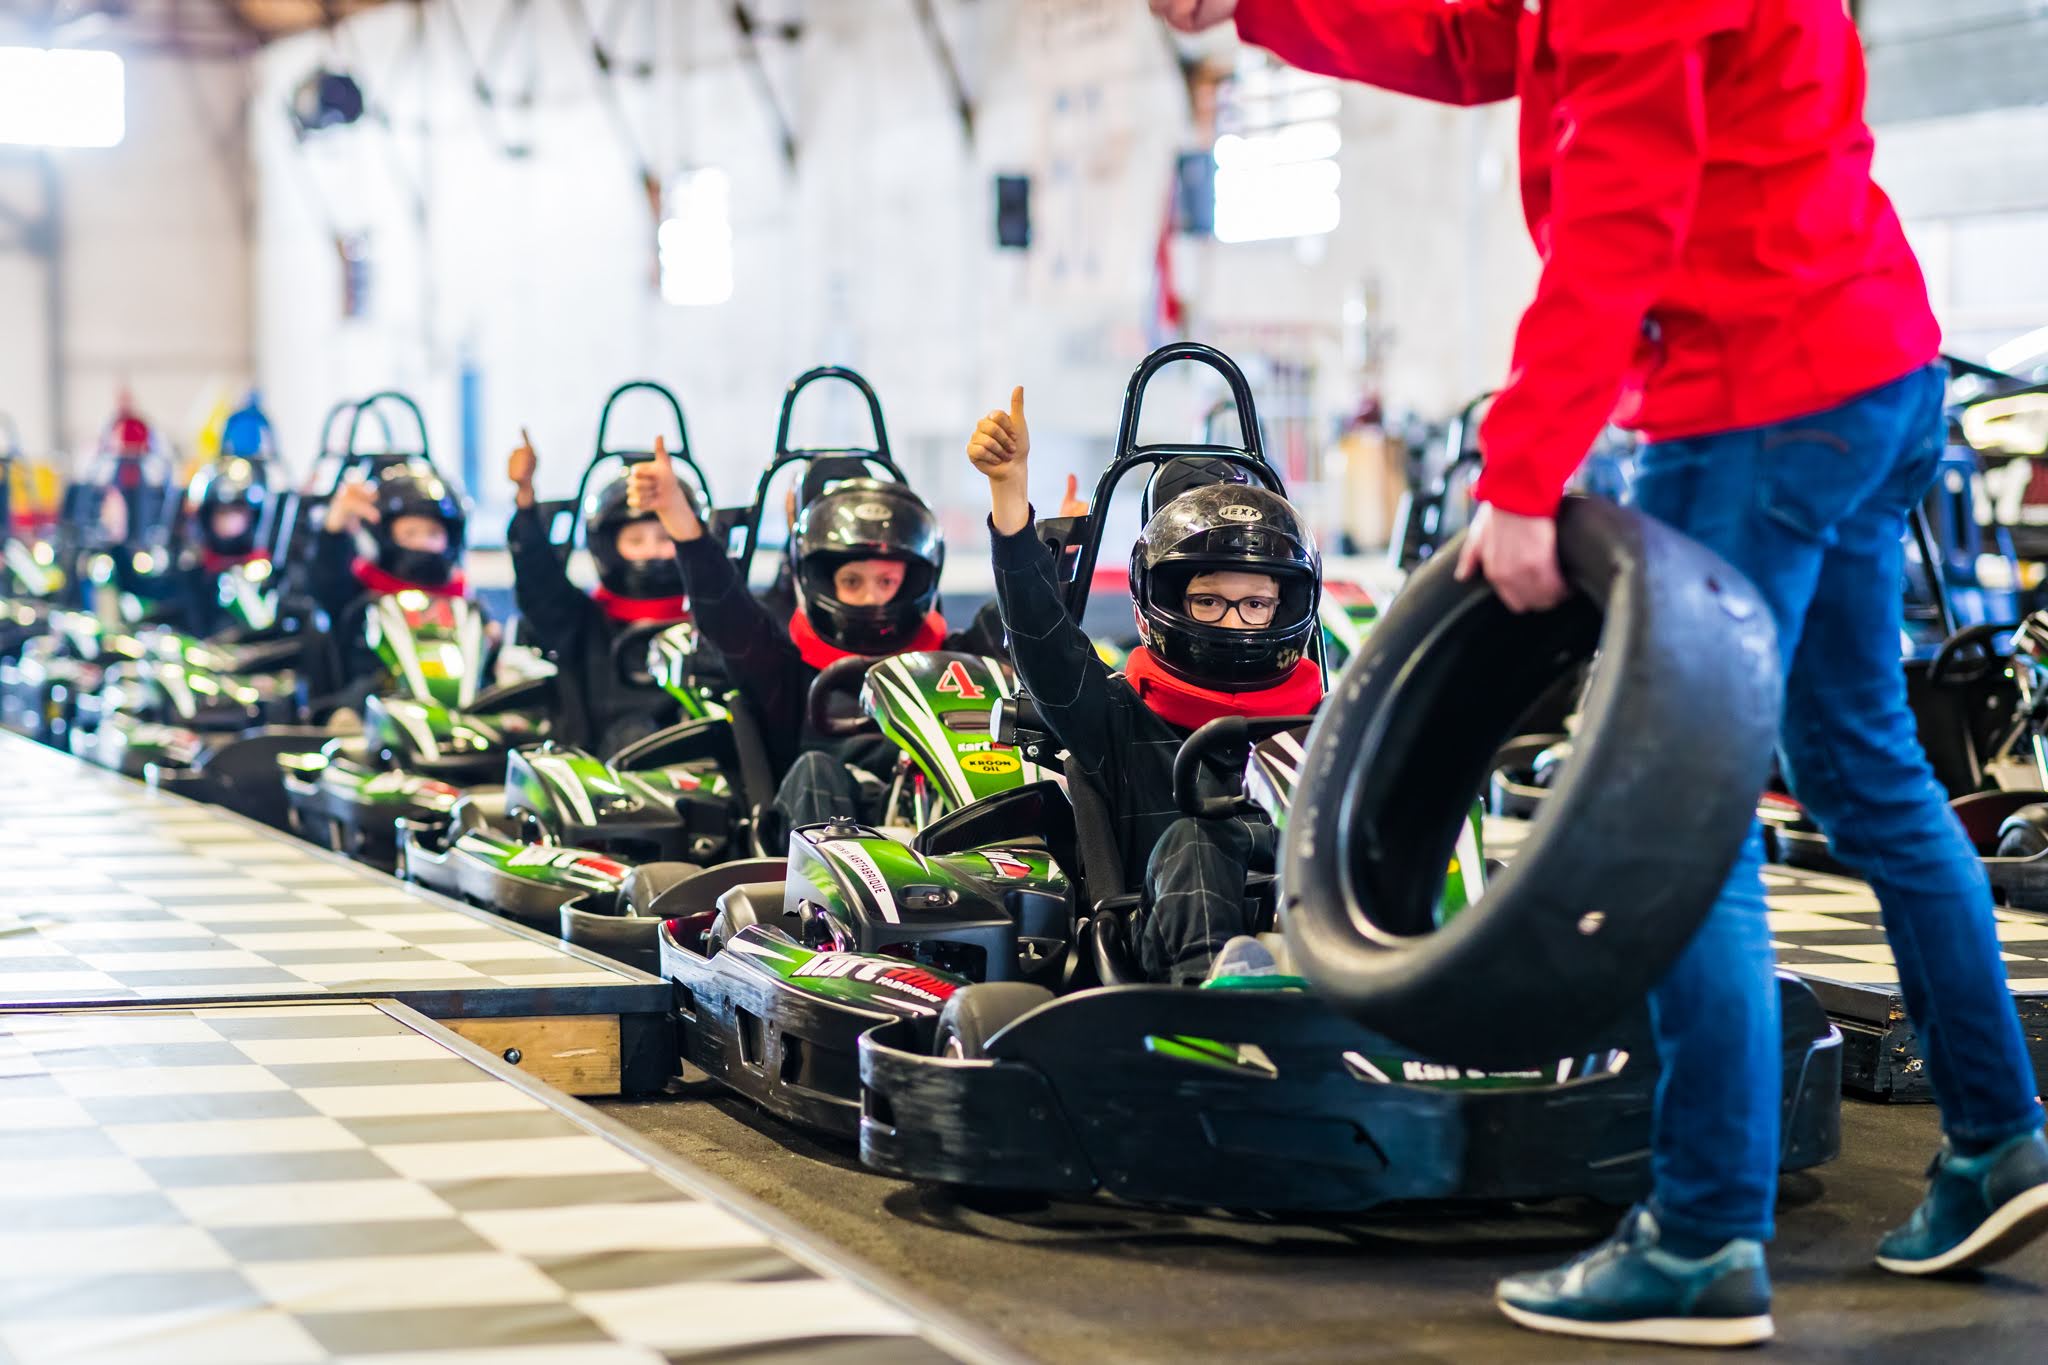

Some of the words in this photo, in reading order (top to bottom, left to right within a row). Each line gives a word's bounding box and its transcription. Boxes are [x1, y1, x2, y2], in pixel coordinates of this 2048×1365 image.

[1221, 508, 1258, 518] JEXX
[936, 661, 985, 699] 4
[875, 976, 943, 1003] FABRIQUE
